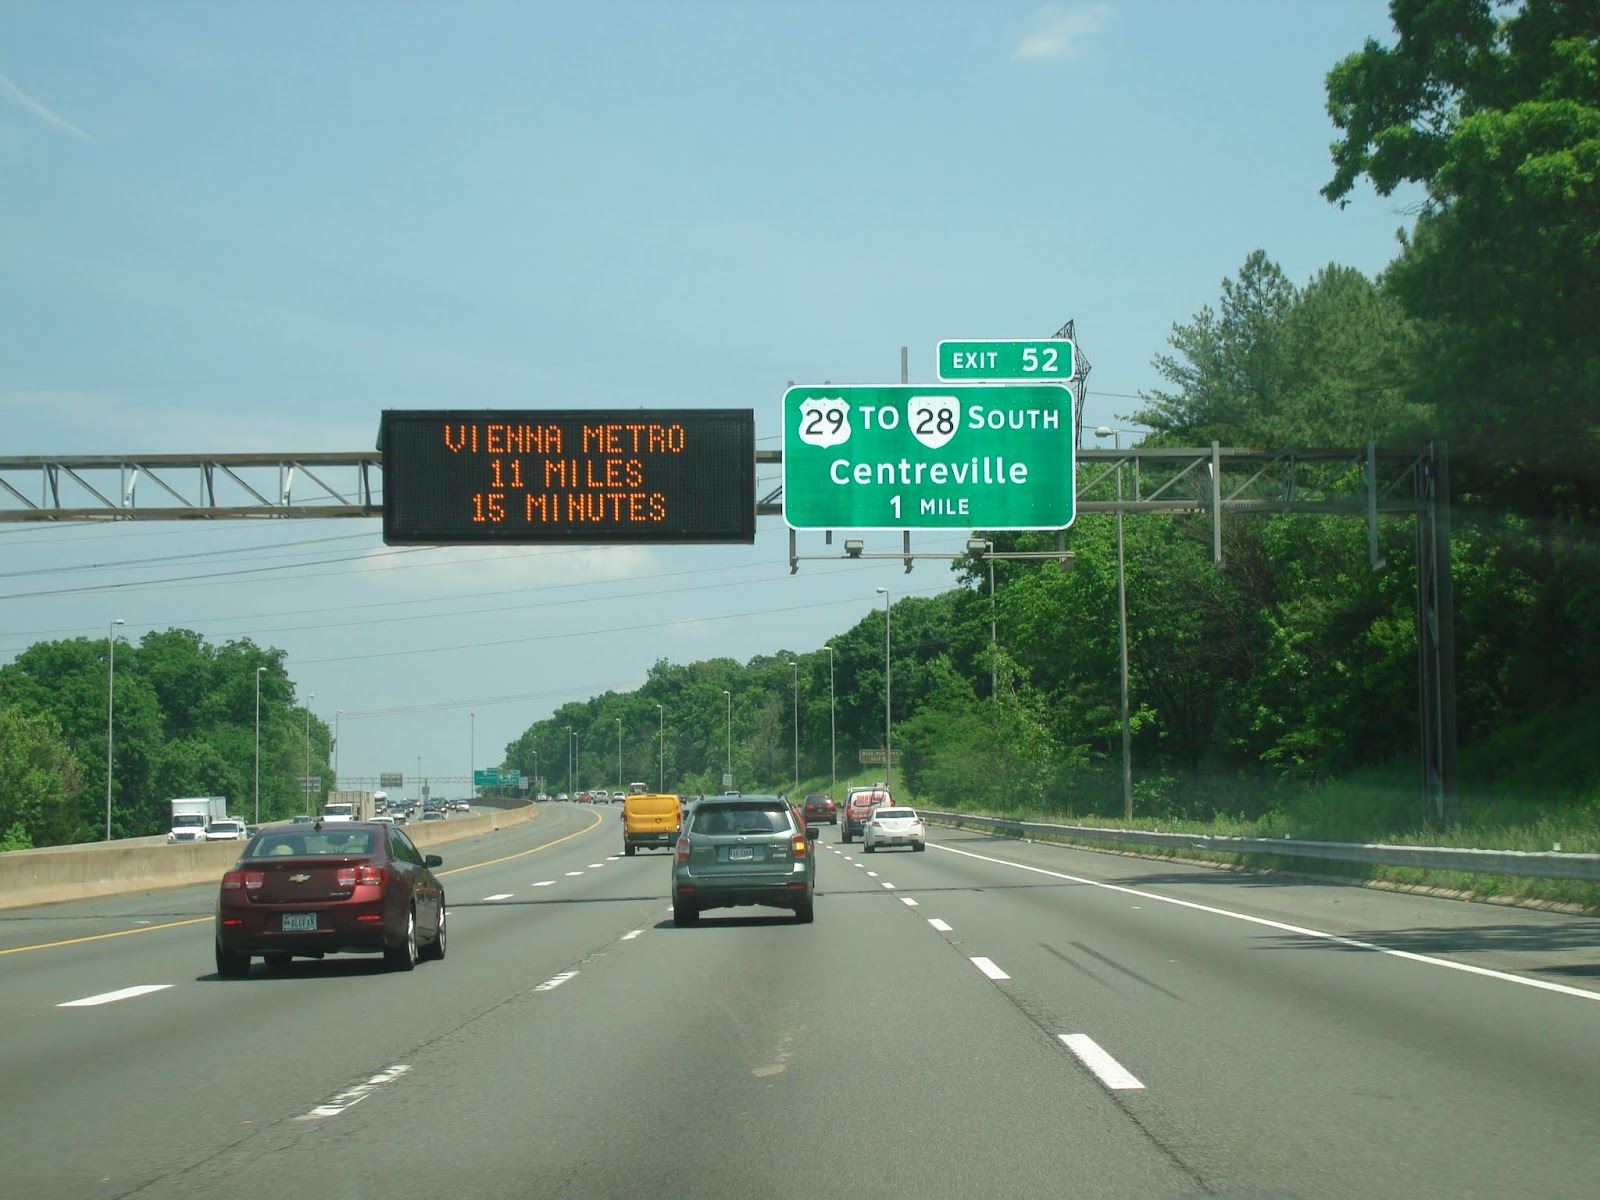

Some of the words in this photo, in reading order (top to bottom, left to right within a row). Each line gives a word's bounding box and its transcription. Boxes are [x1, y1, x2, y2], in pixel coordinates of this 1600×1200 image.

[952, 352, 999, 369] EXIT
[1022, 348, 1058, 372] 52
[805, 408, 844, 435] 29
[859, 406, 899, 430] TO
[916, 408, 954, 435] 28
[968, 406, 1060, 430] SOUTH
[444, 424, 563, 454] VIENNA
[582, 424, 685, 454] METRO
[491, 458, 524, 488] 11
[544, 458, 643, 488] MILES
[829, 457, 1029, 485] Centreville
[472, 493, 505, 522] 15
[526, 492, 666, 522] MINUTES
[889, 495, 902, 519] 1
[920, 499, 970, 515] MILE
